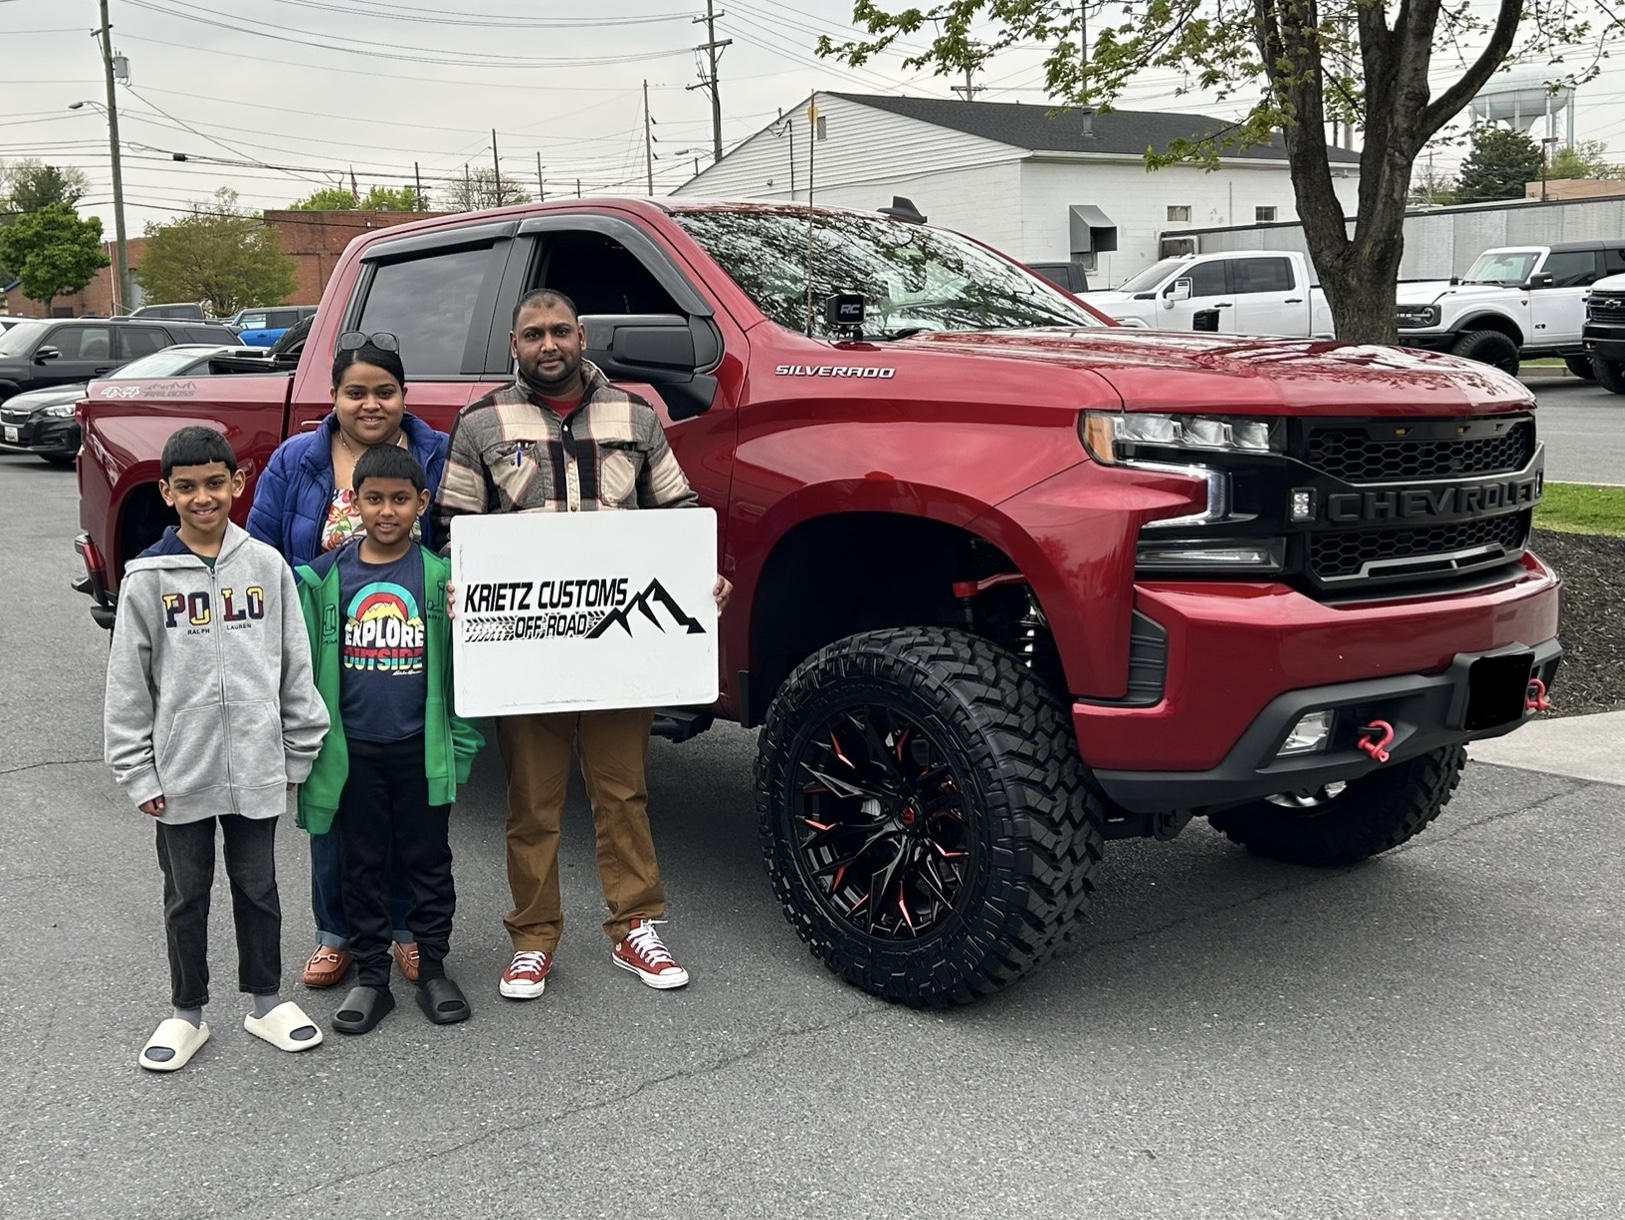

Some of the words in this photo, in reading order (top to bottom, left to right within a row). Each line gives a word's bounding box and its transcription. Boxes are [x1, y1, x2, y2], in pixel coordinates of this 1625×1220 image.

[840, 304, 861, 314] RC
[775, 365, 896, 379] SILVERADO
[1328, 477, 1538, 522] CHEVROLET
[162, 586, 264, 628] POLO
[464, 581, 533, 613] KRIETZ
[538, 577, 629, 610] CUSTOMS
[226, 623, 252, 631] LAUREN
[344, 617, 425, 648] EXPLORE
[514, 616, 543, 638] OFF
[546, 614, 588, 637] ROAD
[344, 647, 424, 671] OUTSIDE
